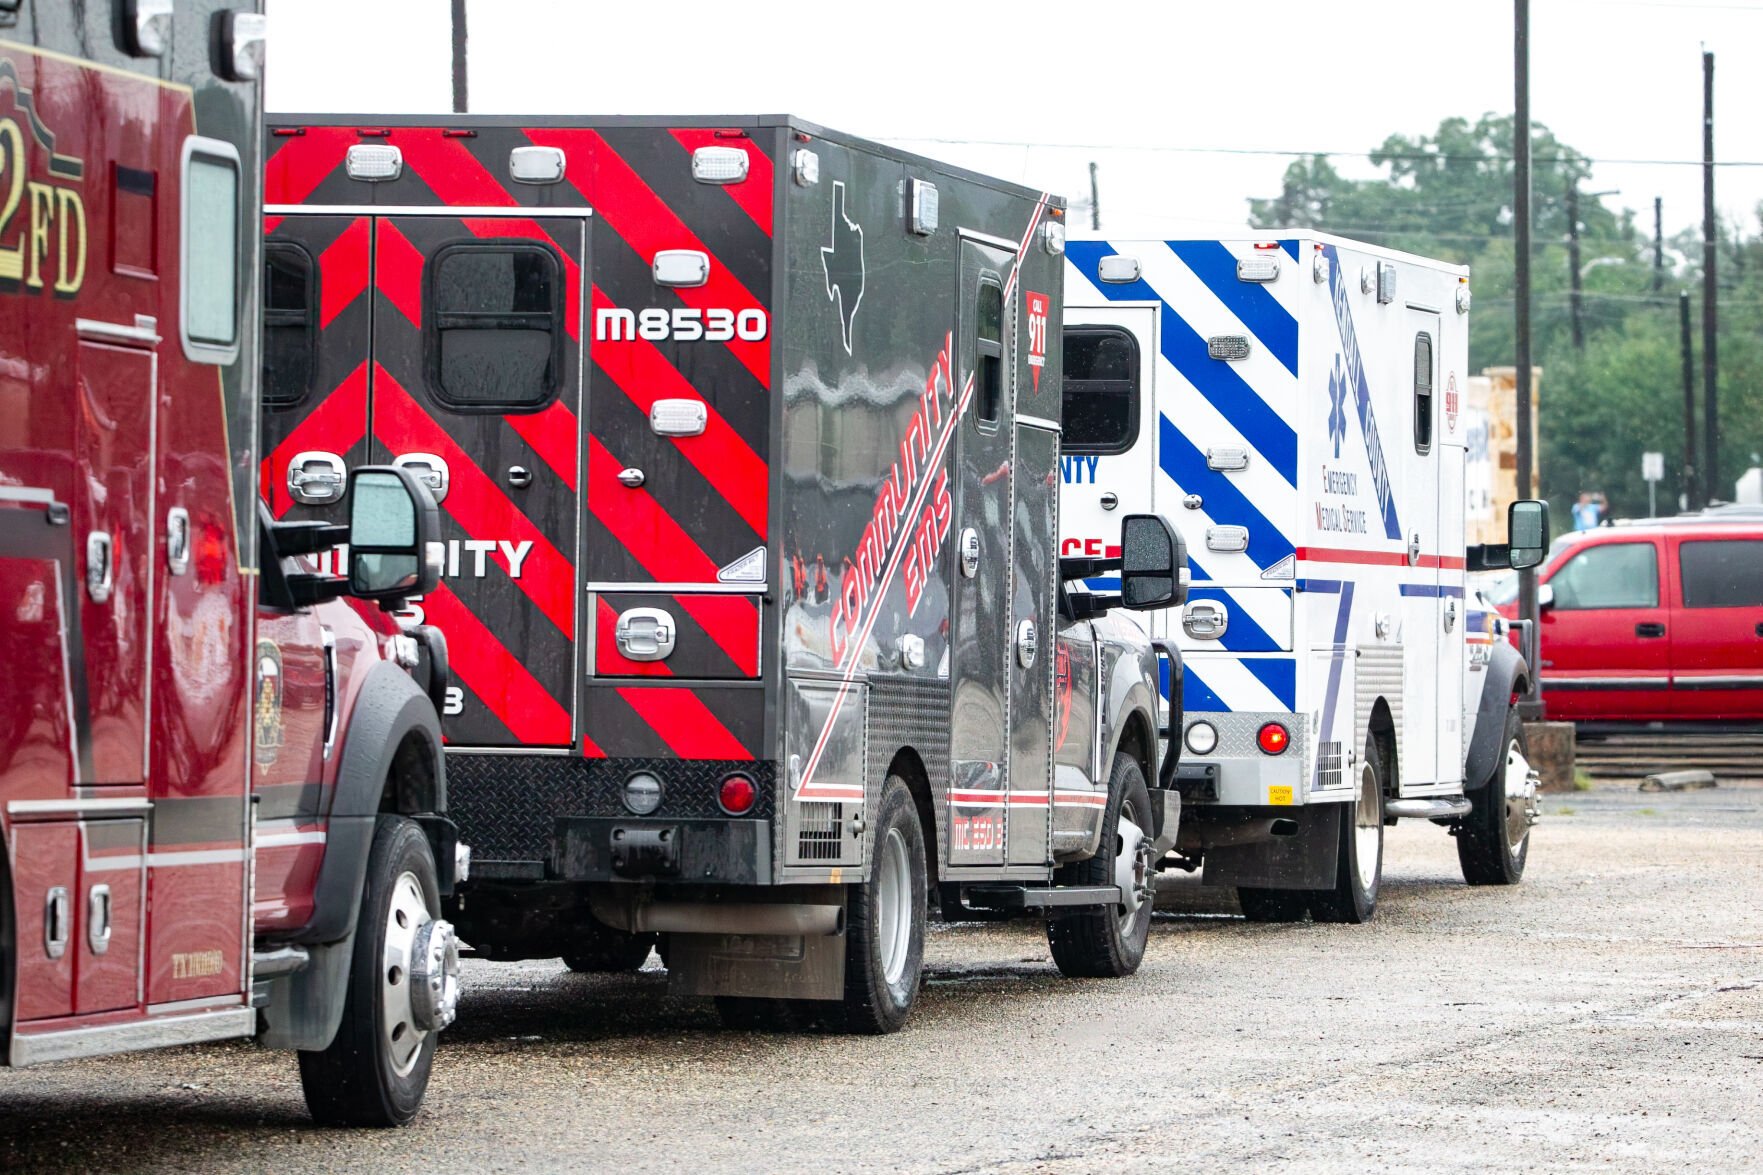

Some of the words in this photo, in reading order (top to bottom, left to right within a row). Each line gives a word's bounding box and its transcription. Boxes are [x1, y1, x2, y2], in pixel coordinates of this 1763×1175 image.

[1029, 313, 1046, 354] 911
[830, 331, 953, 669] COMMUNITY
[904, 467, 951, 619] EMS
